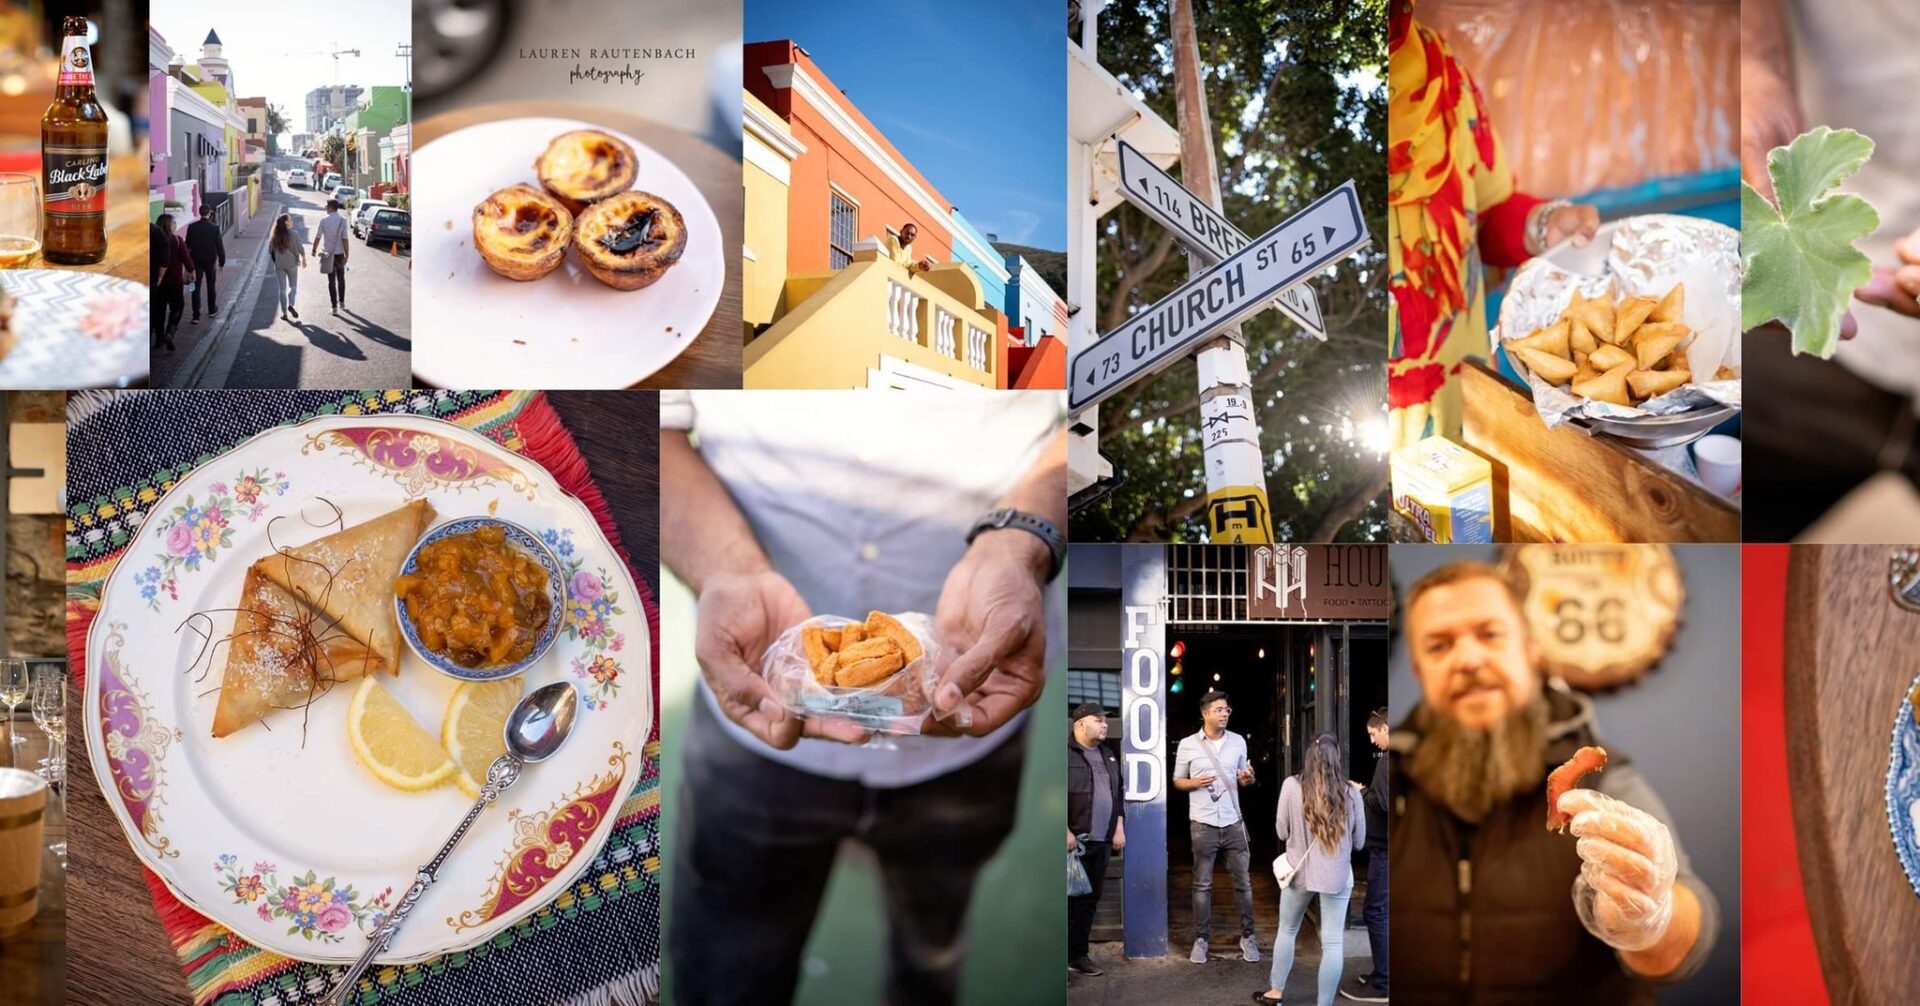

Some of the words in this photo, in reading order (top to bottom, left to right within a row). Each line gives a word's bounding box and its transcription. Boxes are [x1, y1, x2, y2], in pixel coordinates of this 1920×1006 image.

[49, 167, 86, 185] Black
[65, 156, 100, 168] CARLING
[1155, 185, 1182, 218] 114
[1102, 352, 1120, 380] 73
[1131, 262, 1246, 360] CHURCH
[1256, 239, 1279, 271] ST
[1291, 232, 1316, 265] 65
[1211, 427, 1229, 442] 225
[1215, 500, 1258, 534] H
[1397, 494, 1431, 528] ULTRA
[1323, 544, 1386, 588] HOU
[1324, 599, 1349, 607] FOOD
[1554, 597, 1627, 645] 66
[1124, 605, 1163, 802] FOOD
